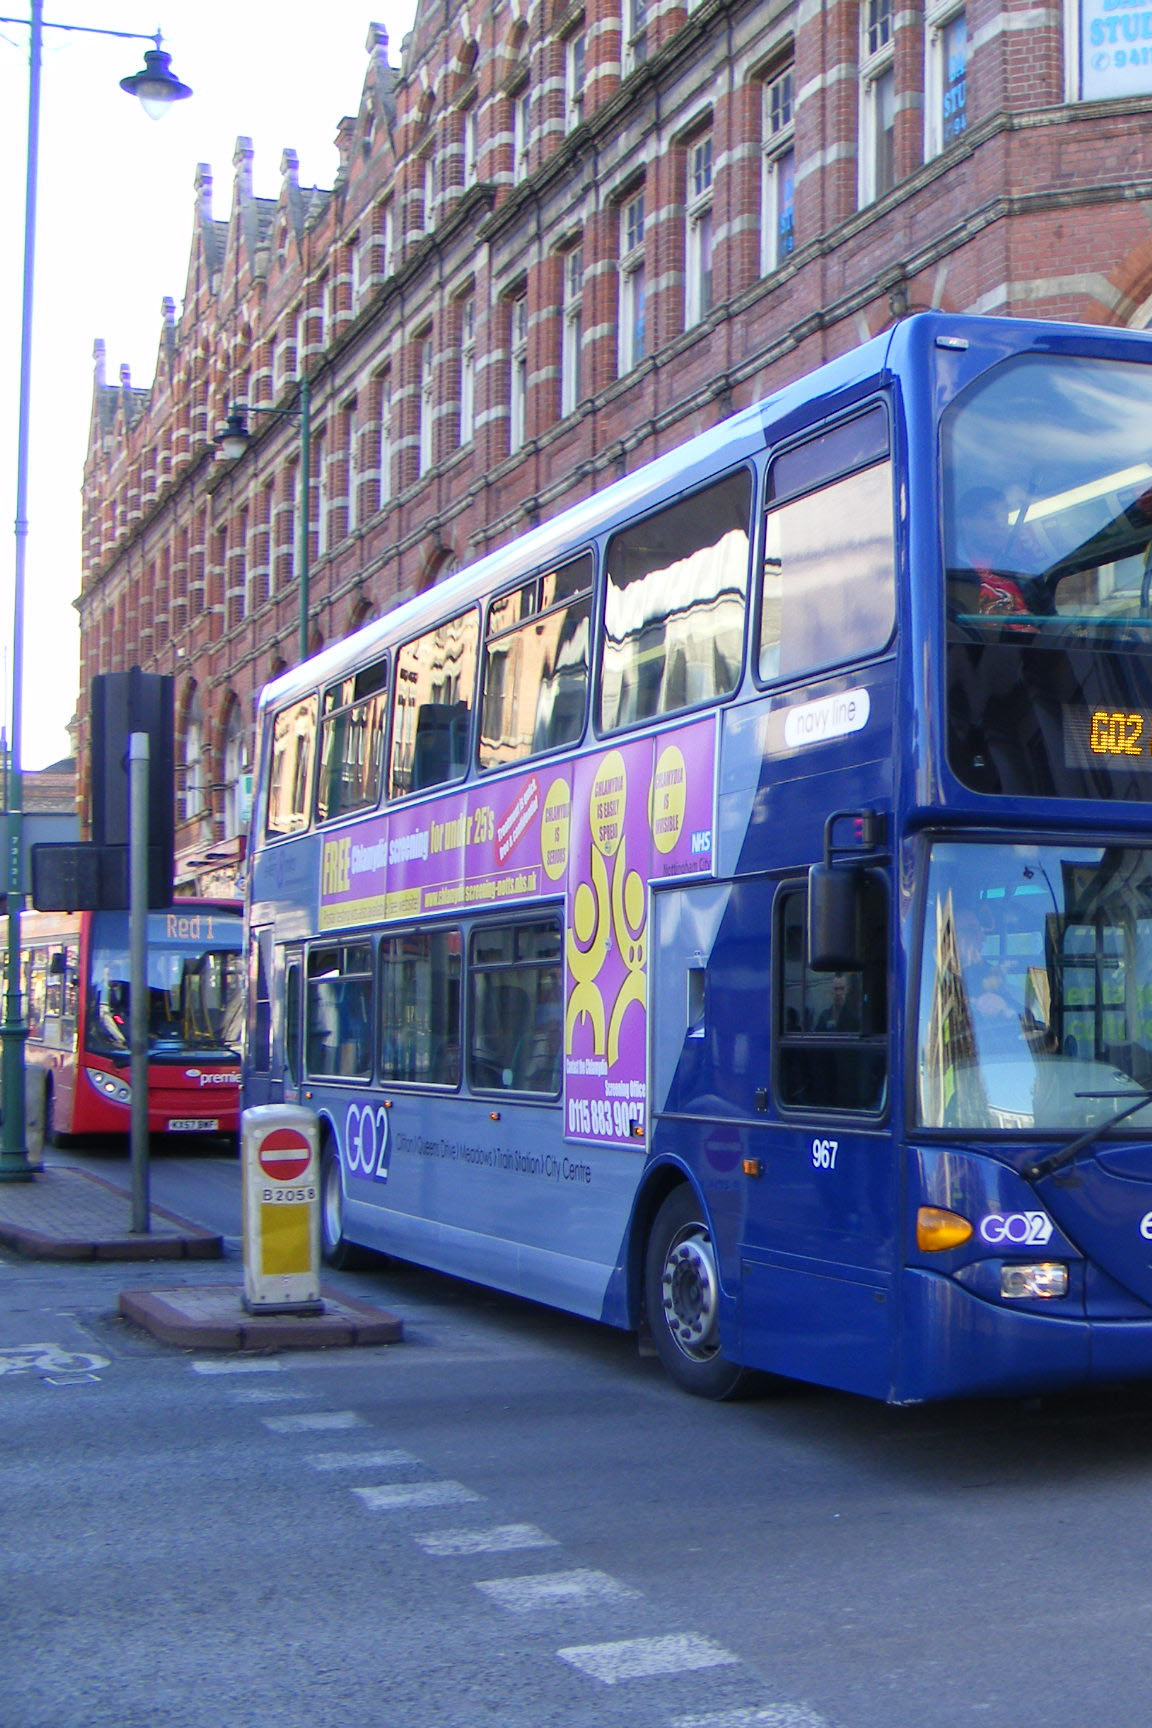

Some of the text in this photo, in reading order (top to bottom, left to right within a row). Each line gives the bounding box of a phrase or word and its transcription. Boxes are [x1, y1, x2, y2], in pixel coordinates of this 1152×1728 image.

[797, 698, 856, 735] navy line
[594, 775, 624, 798] CHLAMYDIA
[322, 836, 351, 896] FREE
[389, 828, 429, 865] screening
[430, 820, 444, 854] for
[473, 805, 494, 844] 25's
[692, 830, 711, 853] NHS
[166, 914, 214, 940] Red 1
[569, 1098, 591, 1134] 0115
[591, 1099, 613, 1136] 883
[346, 1103, 388, 1178] GO2
[812, 1138, 838, 1169] 967
[497, 1148, 513, 1170] Train
[514, 1150, 540, 1174] Station
[545, 1154, 560, 1182] City
[563, 1157, 591, 1183] Centre
[263, 1188, 316, 1201] B2058
[980, 1211, 1052, 1245] GO2
